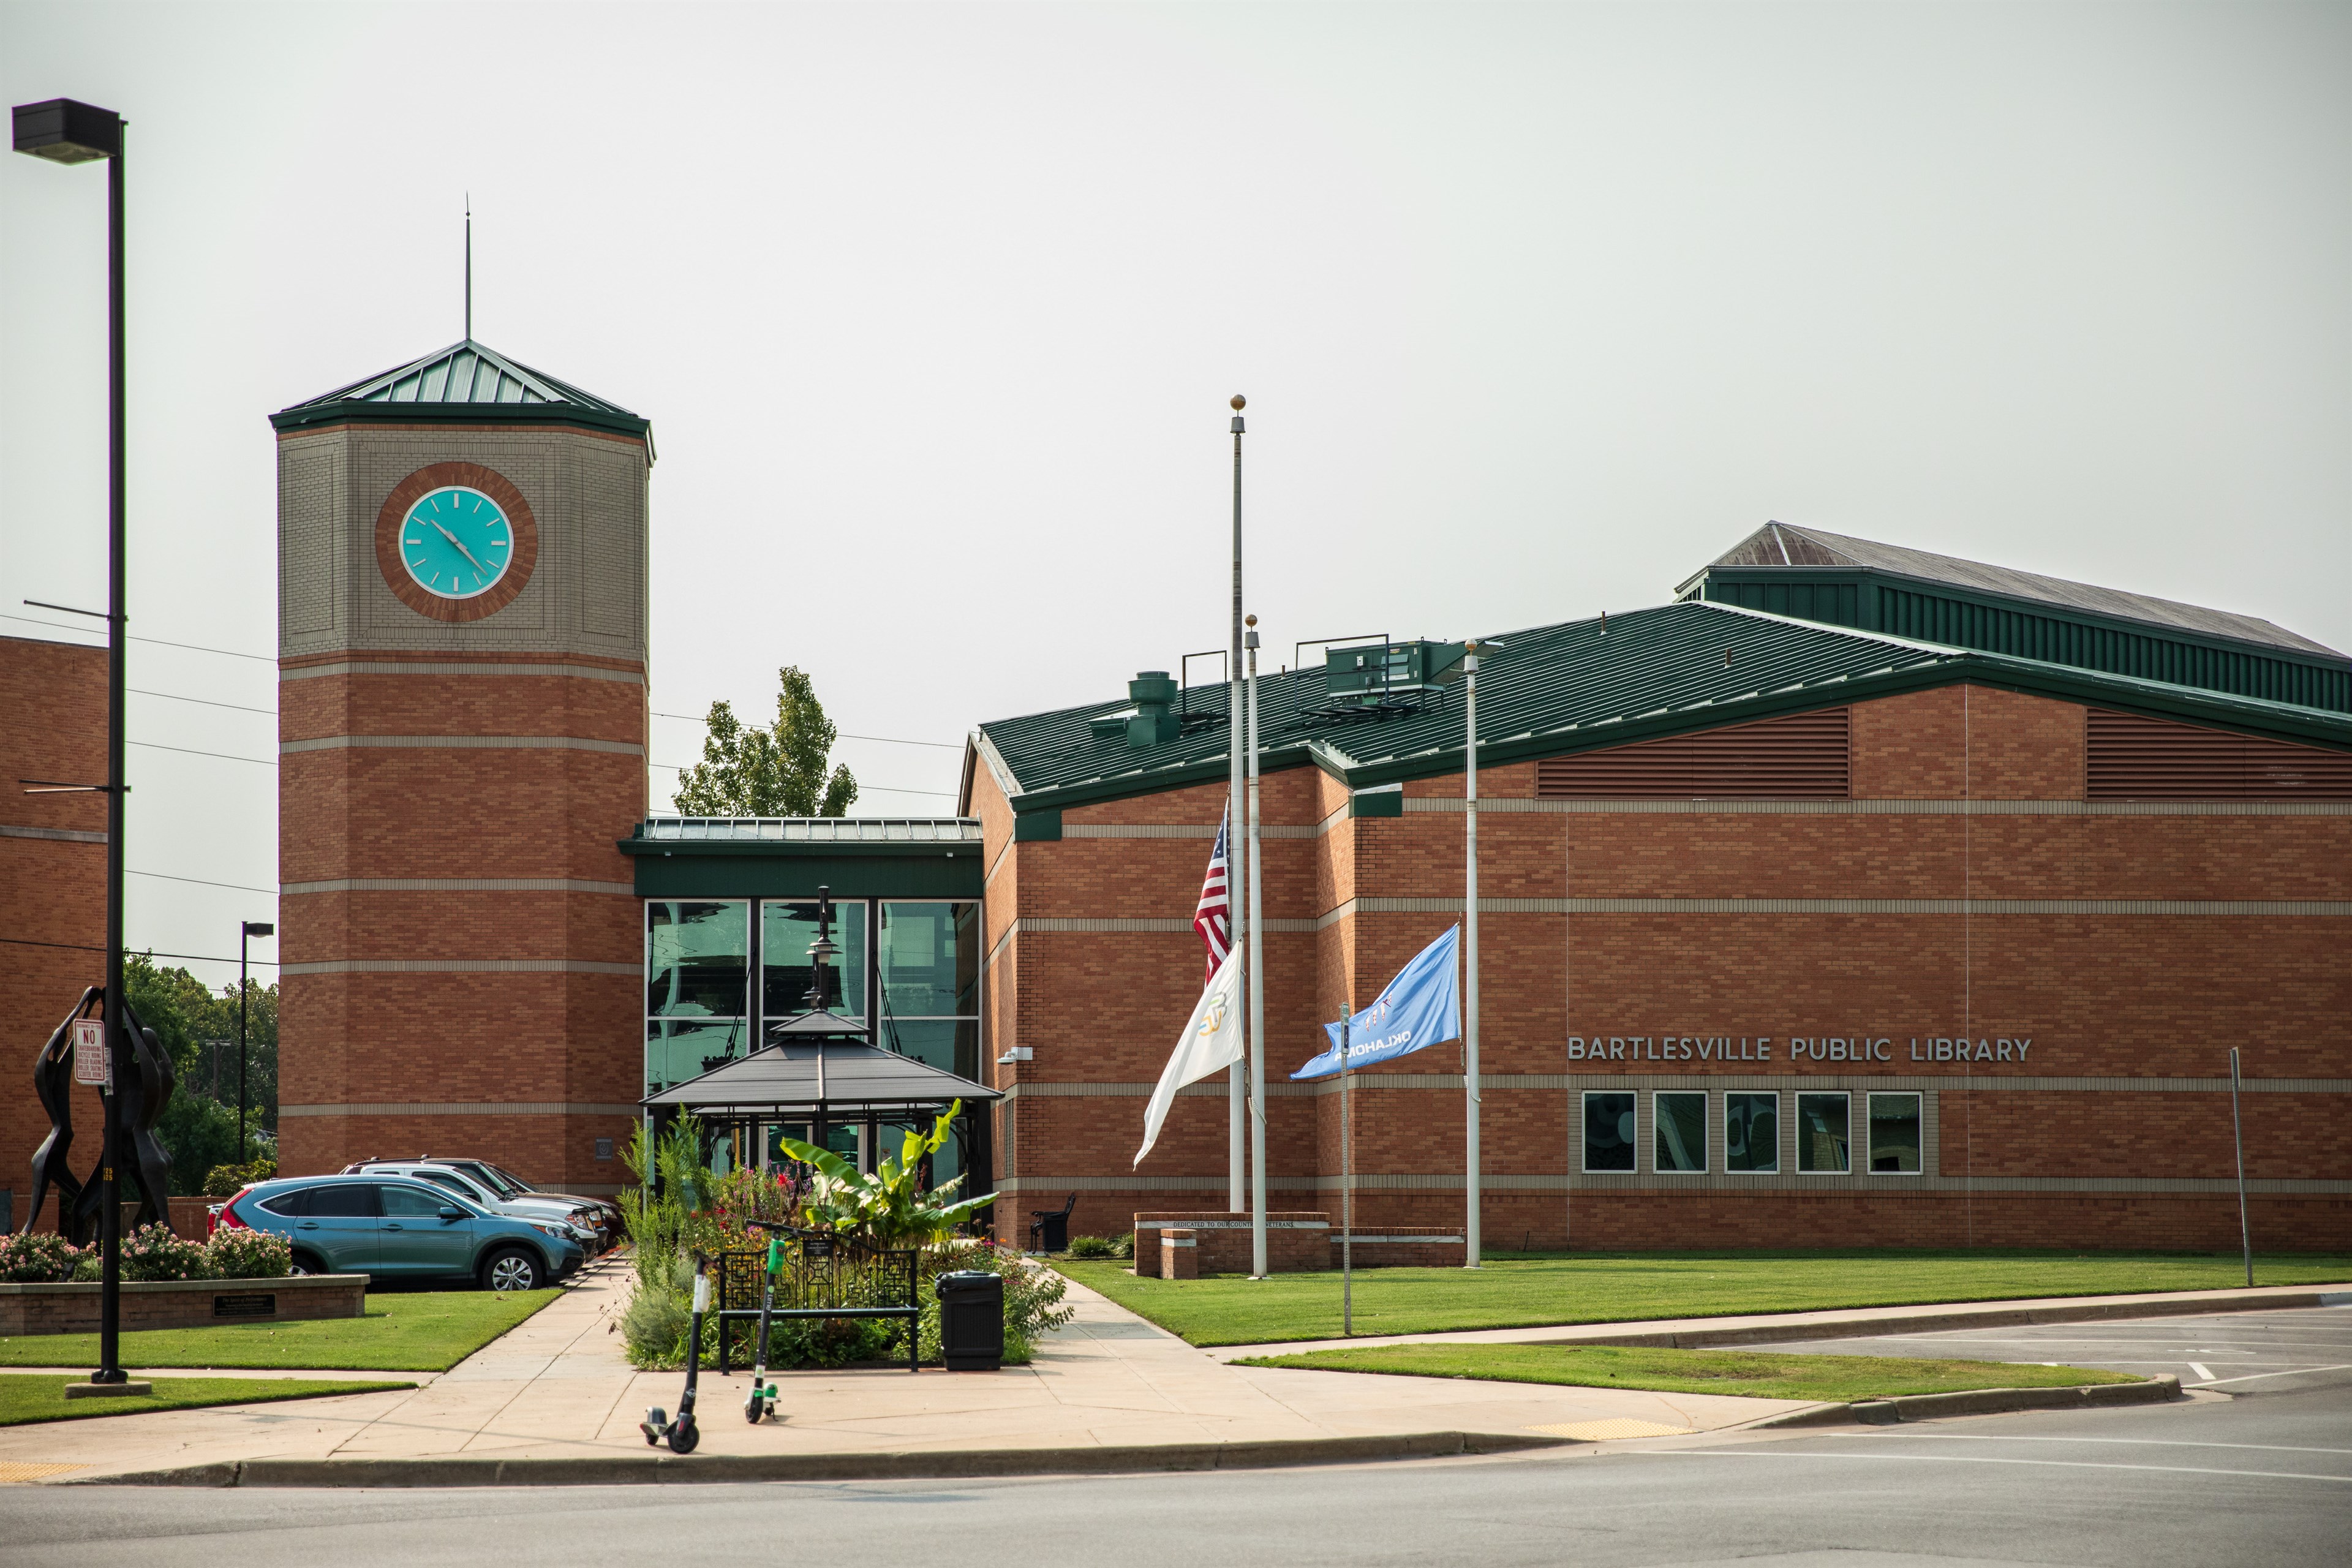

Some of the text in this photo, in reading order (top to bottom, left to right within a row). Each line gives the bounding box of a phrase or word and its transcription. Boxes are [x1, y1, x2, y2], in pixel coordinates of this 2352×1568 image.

[83, 1030, 95, 1044] NO
[1569, 1037, 2032, 1062] BARTLESVILLE PUBLIC LIBRARY
